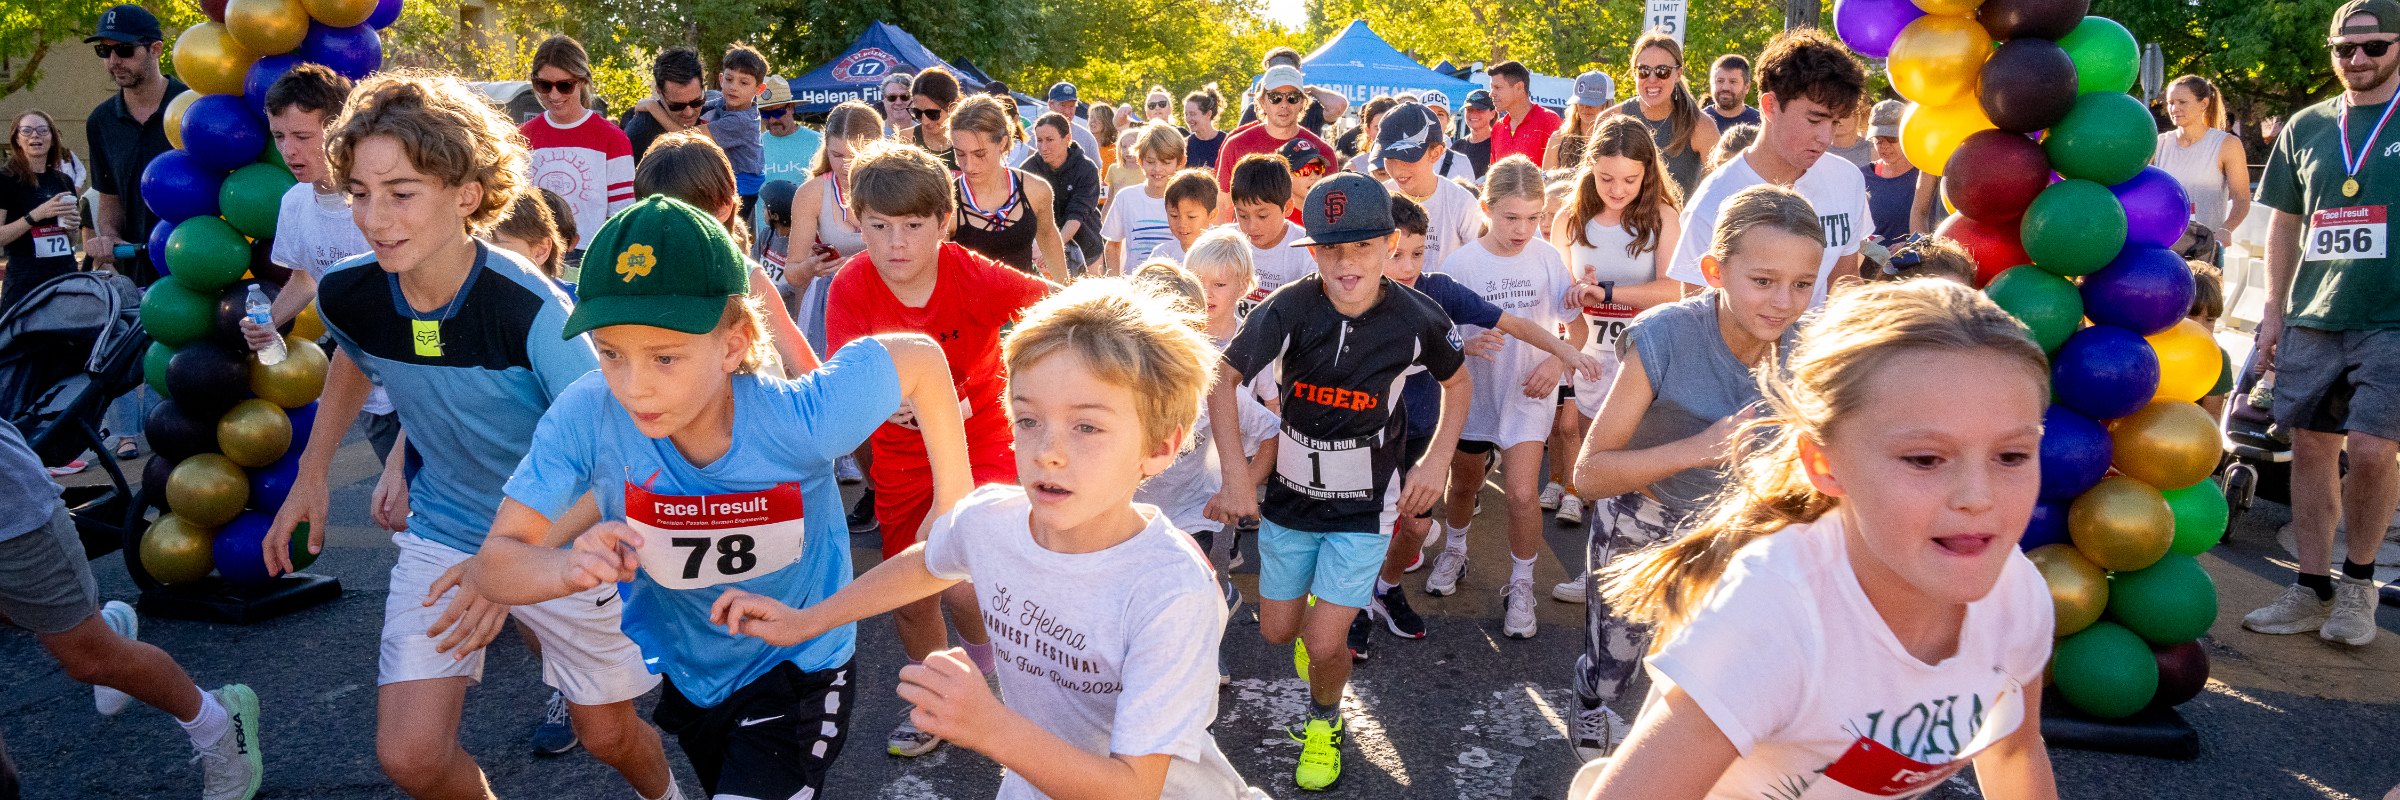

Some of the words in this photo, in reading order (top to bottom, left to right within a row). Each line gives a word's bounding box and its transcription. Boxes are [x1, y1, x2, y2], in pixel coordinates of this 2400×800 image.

[1653, 3, 1679, 12] LIMIT
[1653, 15, 1676, 35] 15
[854, 62, 880, 75] 17
[802, 89, 859, 104] Helena
[1422, 92, 1447, 105] LGCC
[2321, 210, 2339, 220] race
[2342, 208, 2369, 218] result
[46, 237, 68, 253] 72
[2316, 227, 2373, 255] 956
[1501, 278, 1532, 291] Helena
[1510, 289, 1537, 298] FESTIVAL
[1593, 319, 1626, 345] 79
[1286, 425, 1291, 435] 1
[1291, 430, 1308, 447] MILE
[1310, 440, 1331, 451] FUN
[1333, 439, 1357, 450] RUN
[1308, 451, 1326, 489] 1
[1286, 481, 1307, 494] HELENA
[1307, 487, 1336, 499] HARVEST
[1336, 490, 1368, 499] FESTIVAL
[654, 501, 698, 517] race
[709, 496, 768, 516] result
[671, 533, 757, 579] 78
[992, 582, 1012, 617] St.
[1020, 599, 1087, 652] Helena
[983, 608, 1030, 648] HARVEST
[1035, 638, 1100, 674] FESTIVAL
[994, 642, 1012, 664] 1mi
[1016, 655, 1045, 677] Fun
[1049, 670, 1080, 692] Run
[1081, 680, 1123, 695] 2024
[232, 712, 248, 755] HOKA
